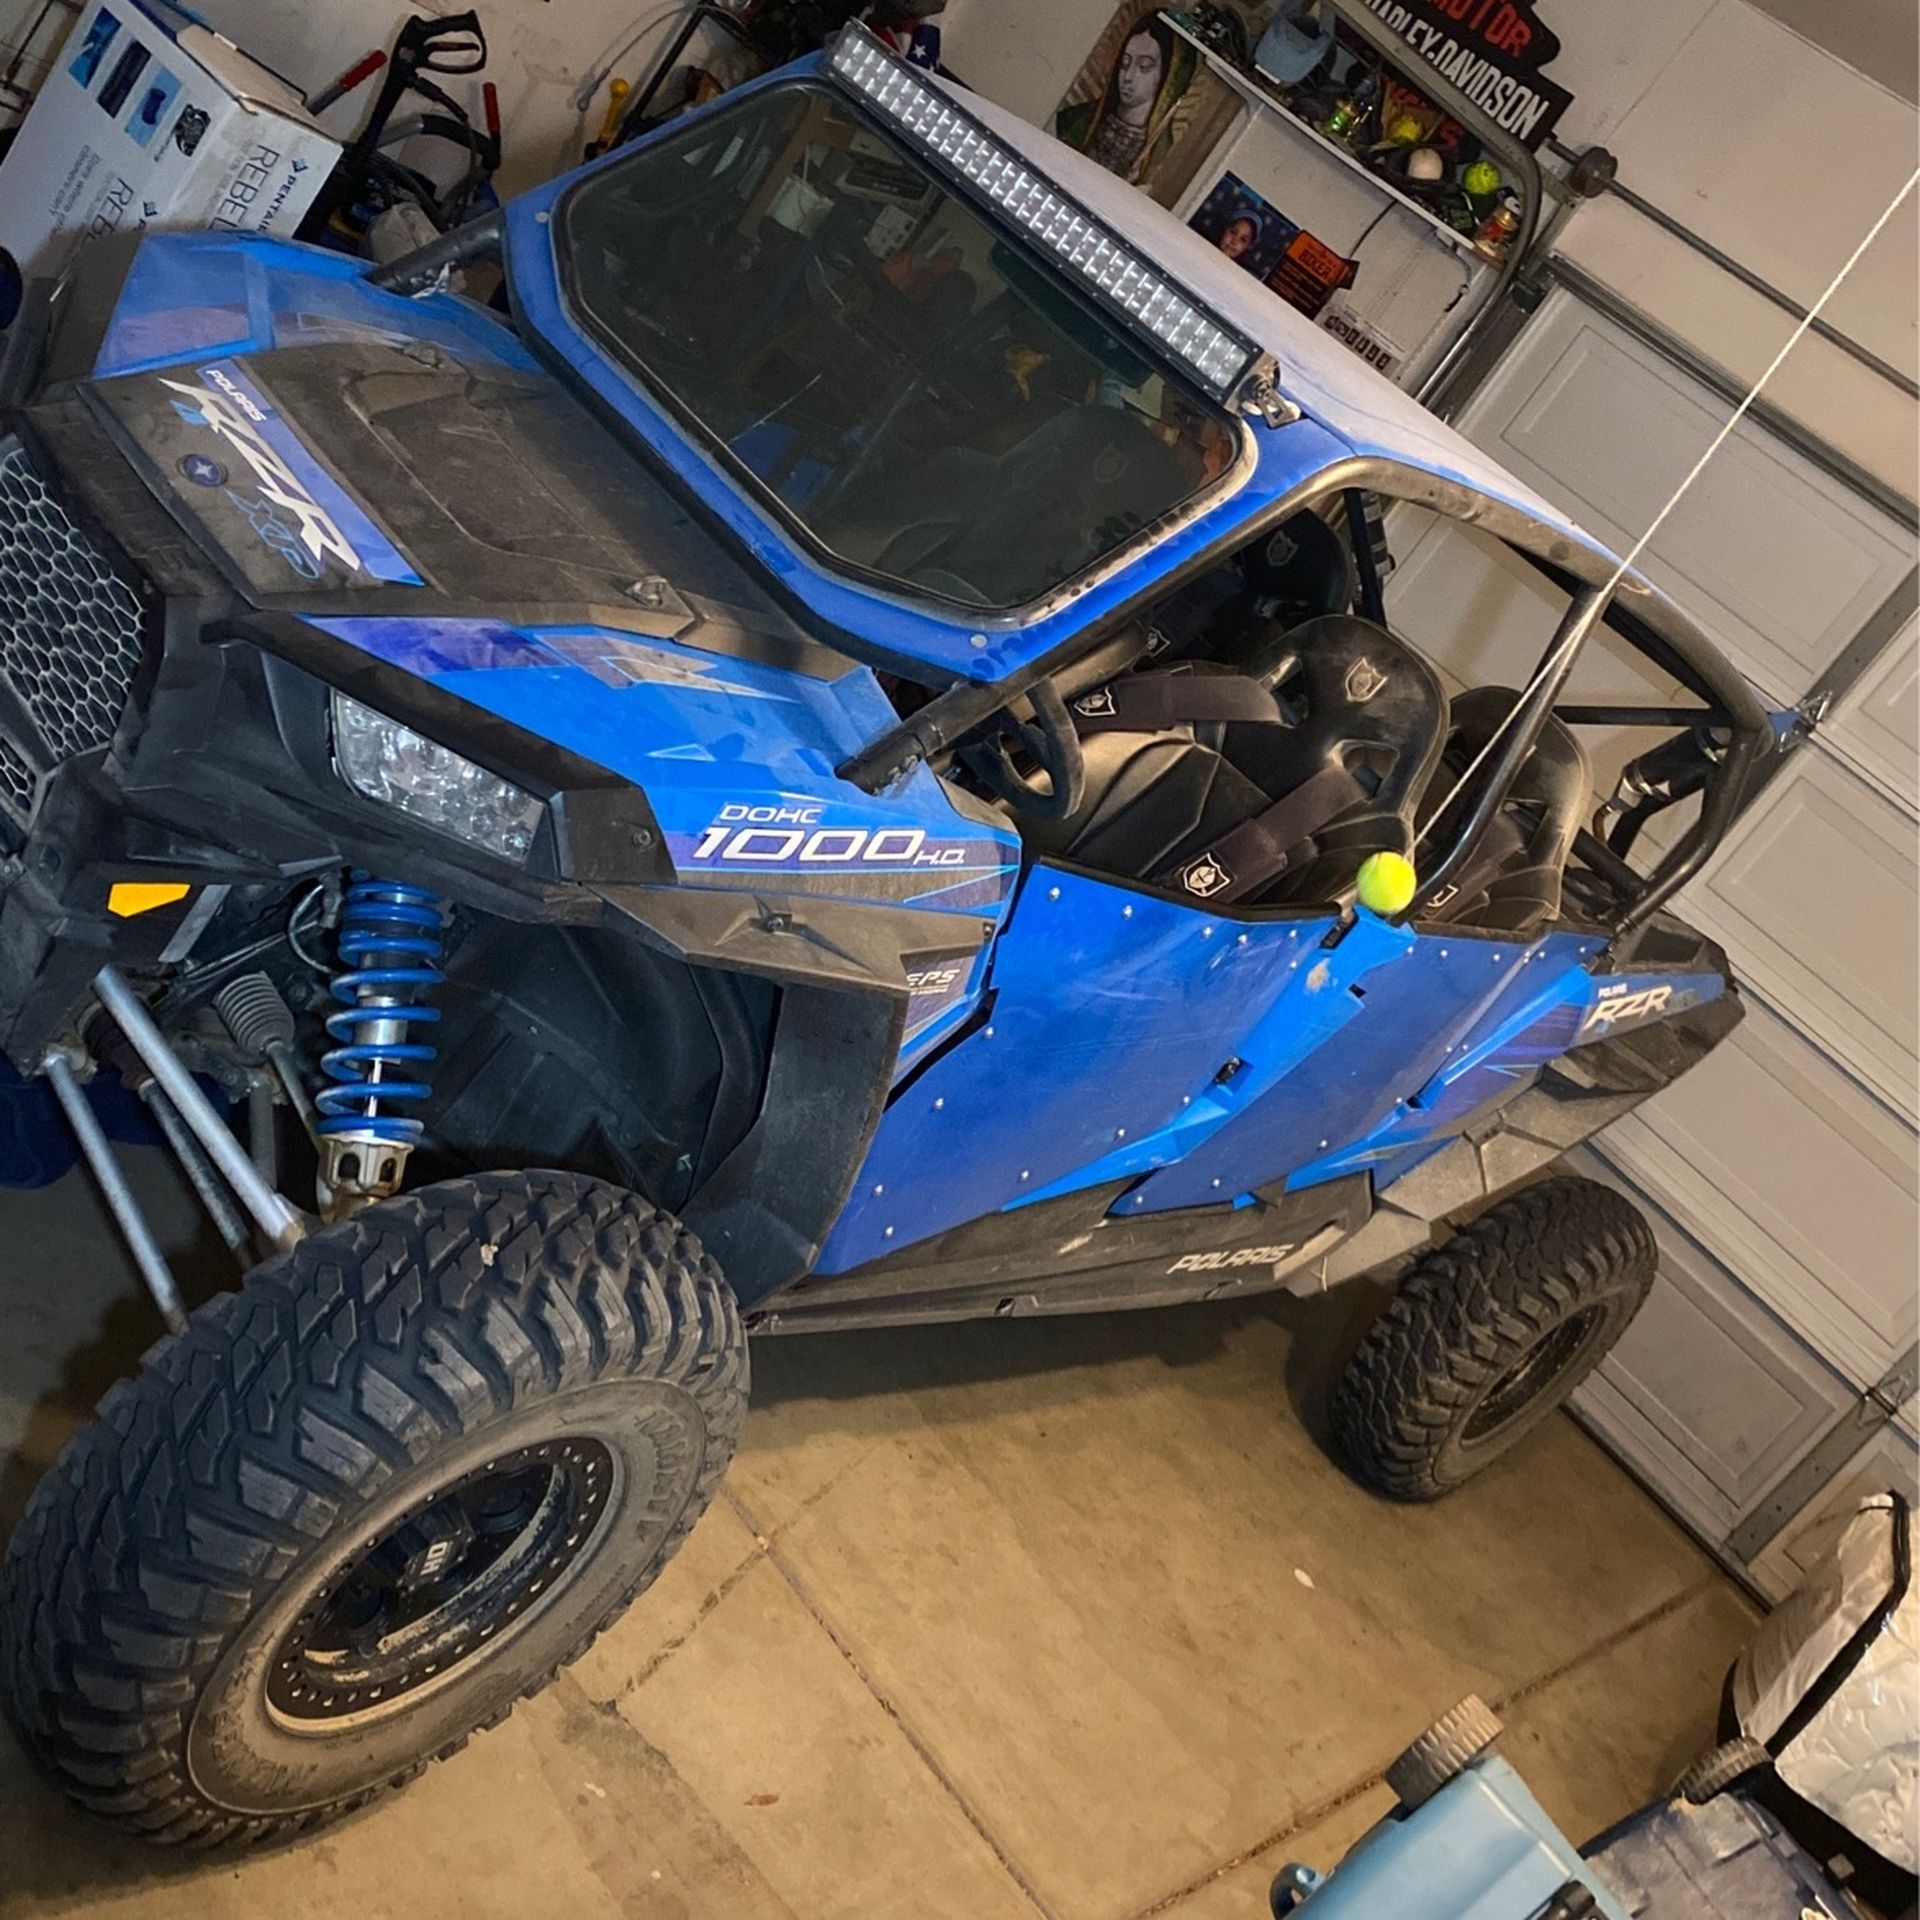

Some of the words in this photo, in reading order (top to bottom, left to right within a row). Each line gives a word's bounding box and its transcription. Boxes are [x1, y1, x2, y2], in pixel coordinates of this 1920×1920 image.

[1364, 0, 1549, 140] ARLEY-DAVIDSON
[208, 145, 281, 231] REBEL
[1298, 249, 1332, 279] BIKER
[205, 369, 267, 422] POLARIS
[157, 378, 361, 572] RZR
[719, 804, 823, 824] DOHC
[693, 827, 926, 862] 1000
[906, 968, 960, 987] EPS
[1582, 985, 1673, 1031] RZR
[1165, 1244, 1295, 1275] POLARIS
